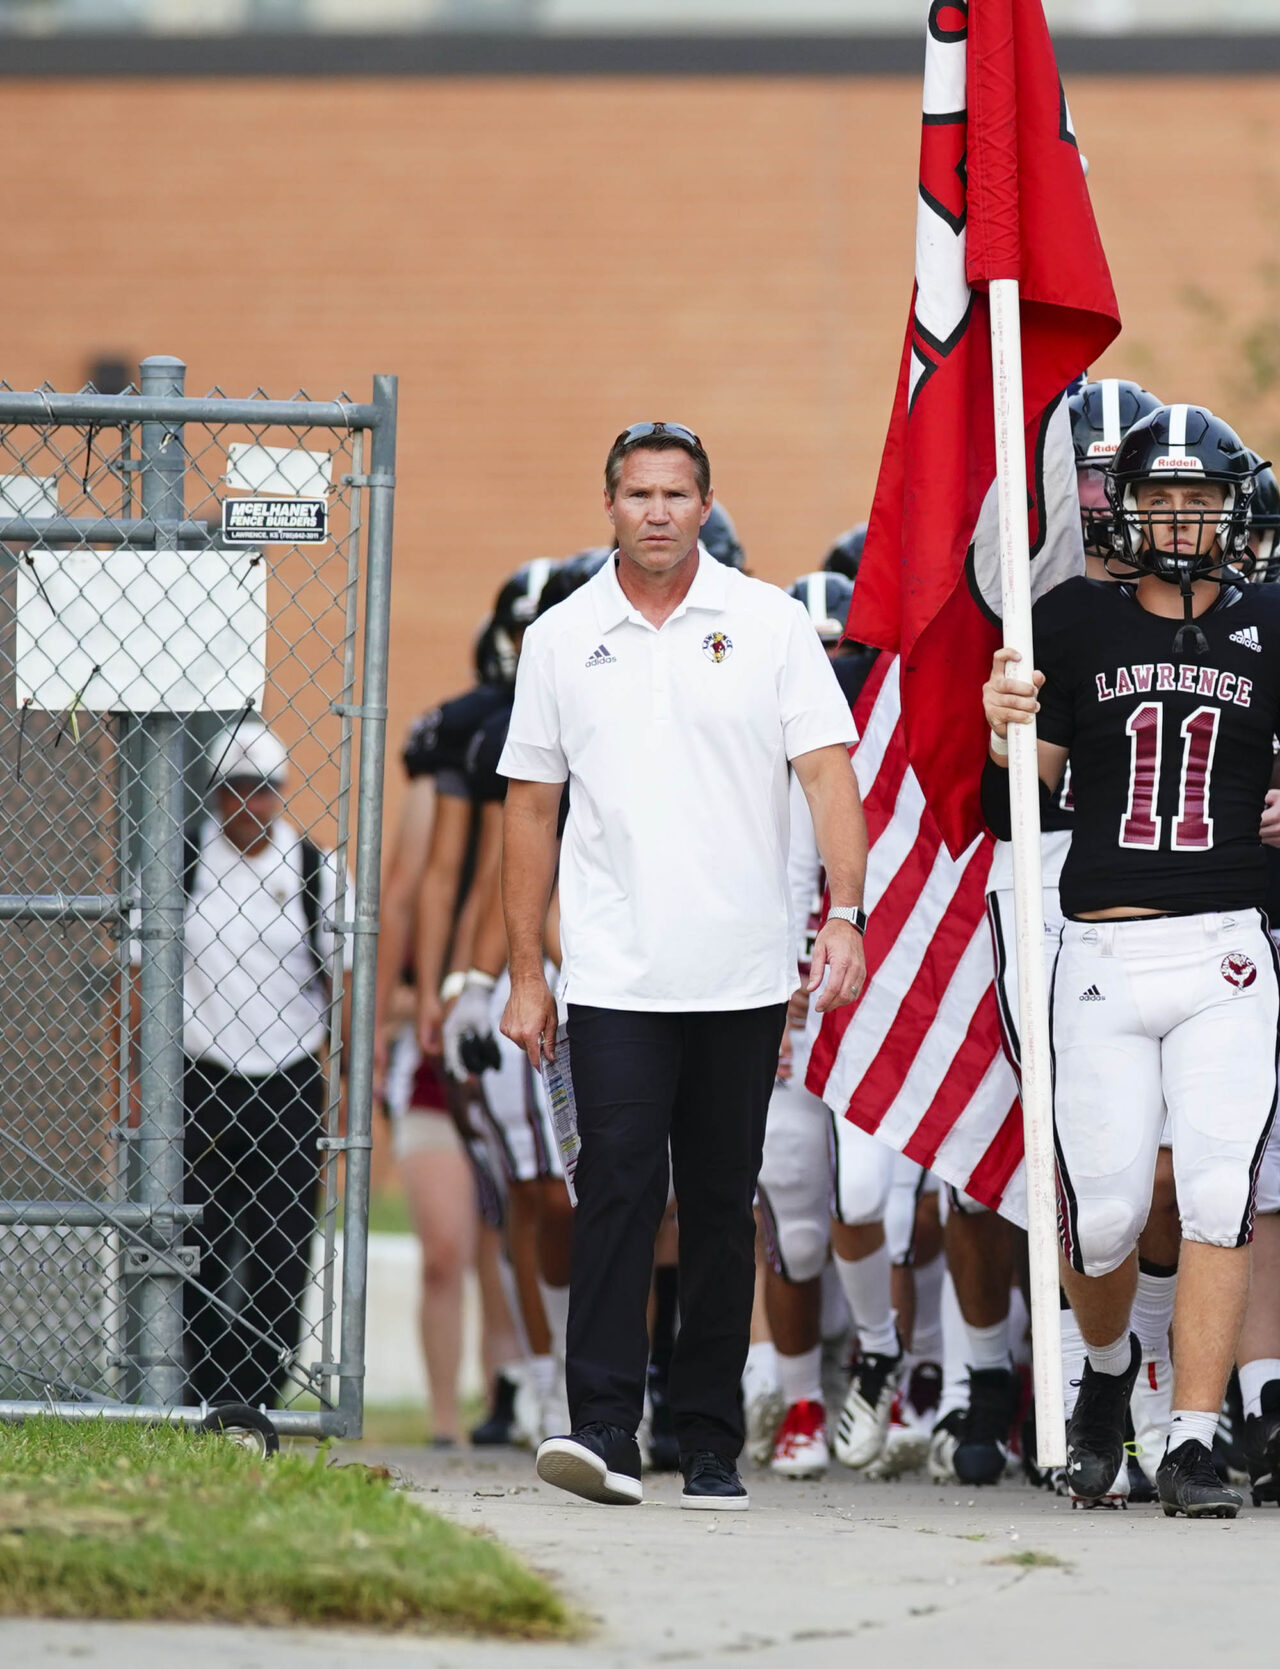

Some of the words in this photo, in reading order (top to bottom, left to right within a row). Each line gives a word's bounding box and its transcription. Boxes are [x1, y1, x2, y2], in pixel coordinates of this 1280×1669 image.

[1093, 445, 1119, 453] Ridd
[1158, 459, 1197, 468] Riddell
[229, 516, 265, 527] FENCE
[266, 517, 318, 528] BUILDERS
[1228, 633, 1262, 653] adidas
[585, 656, 617, 669] adidas
[1095, 663, 1254, 709] LAWRENCE
[1118, 701, 1222, 852] 11
